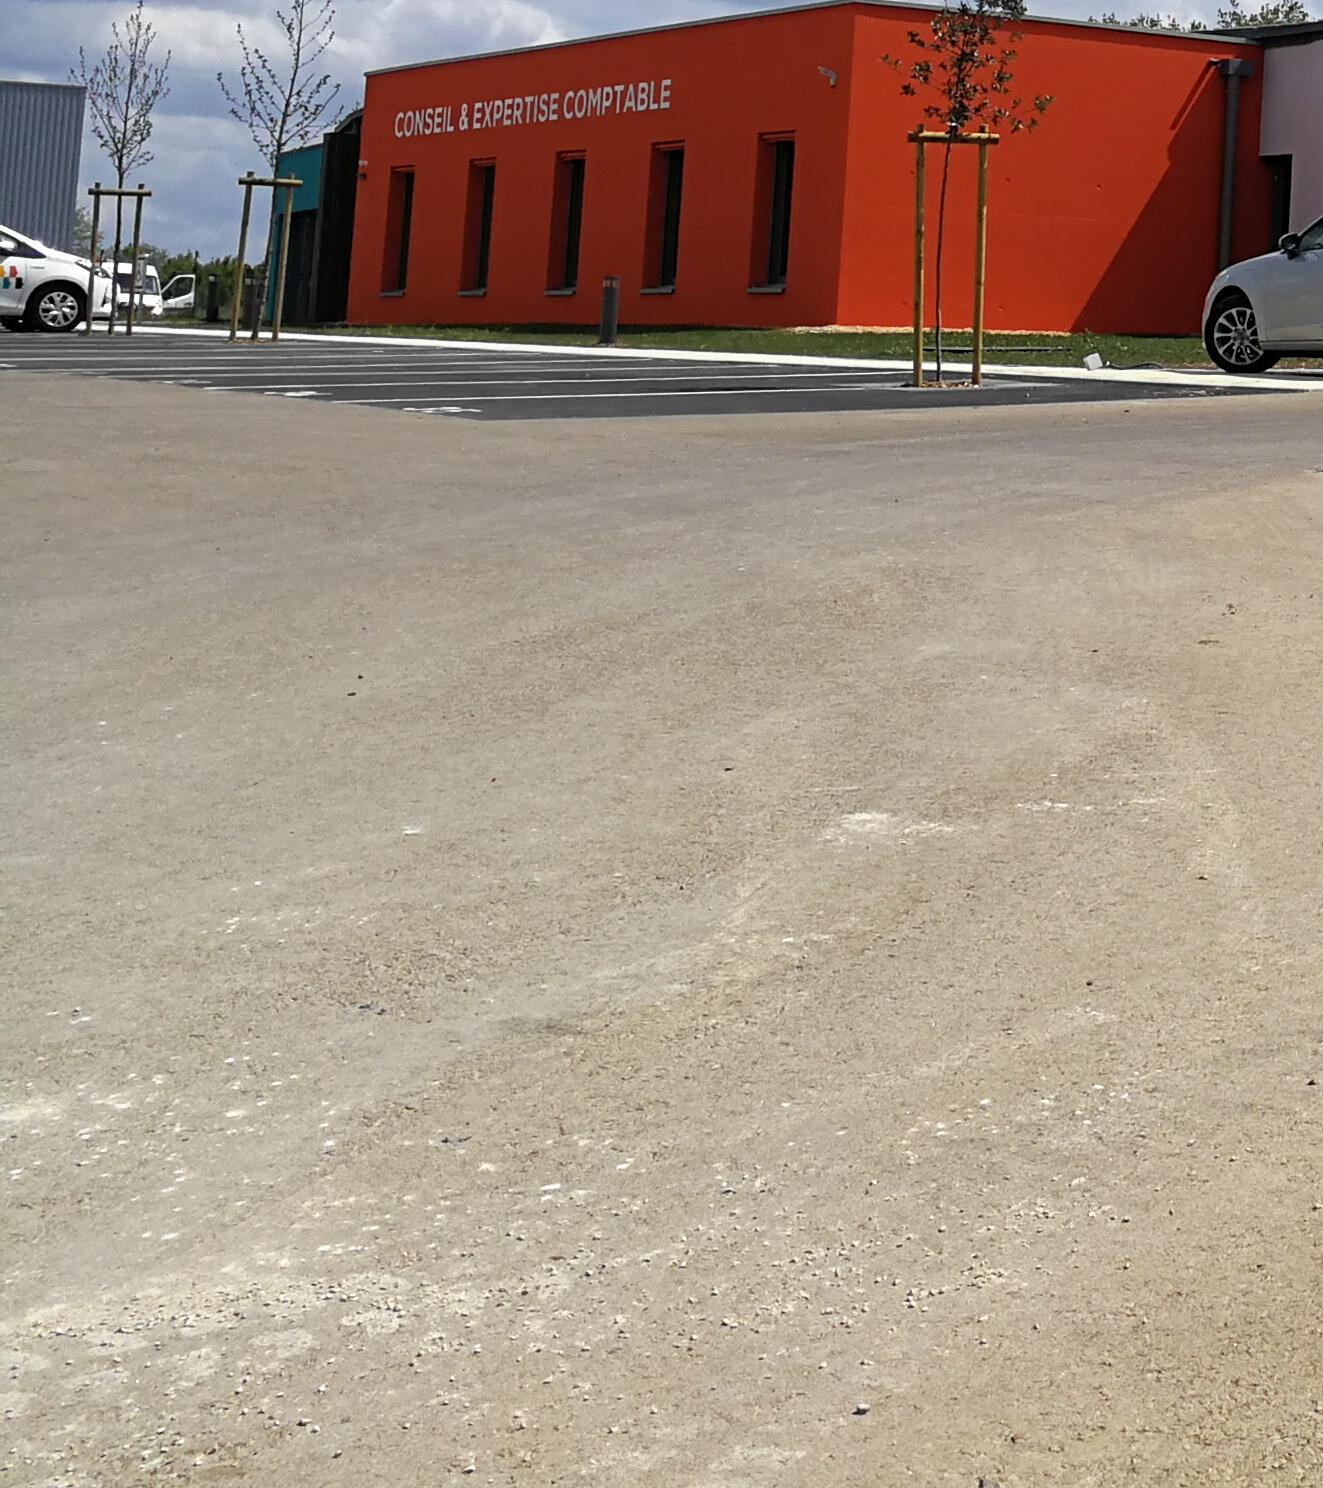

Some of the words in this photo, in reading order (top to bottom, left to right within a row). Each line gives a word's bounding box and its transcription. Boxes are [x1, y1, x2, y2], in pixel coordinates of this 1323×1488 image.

[394, 105, 455, 138] CONSEIL
[458, 102, 469, 131] &
[472, 92, 560, 129] EXPERTISE
[562, 78, 672, 120] COMPTABLE
